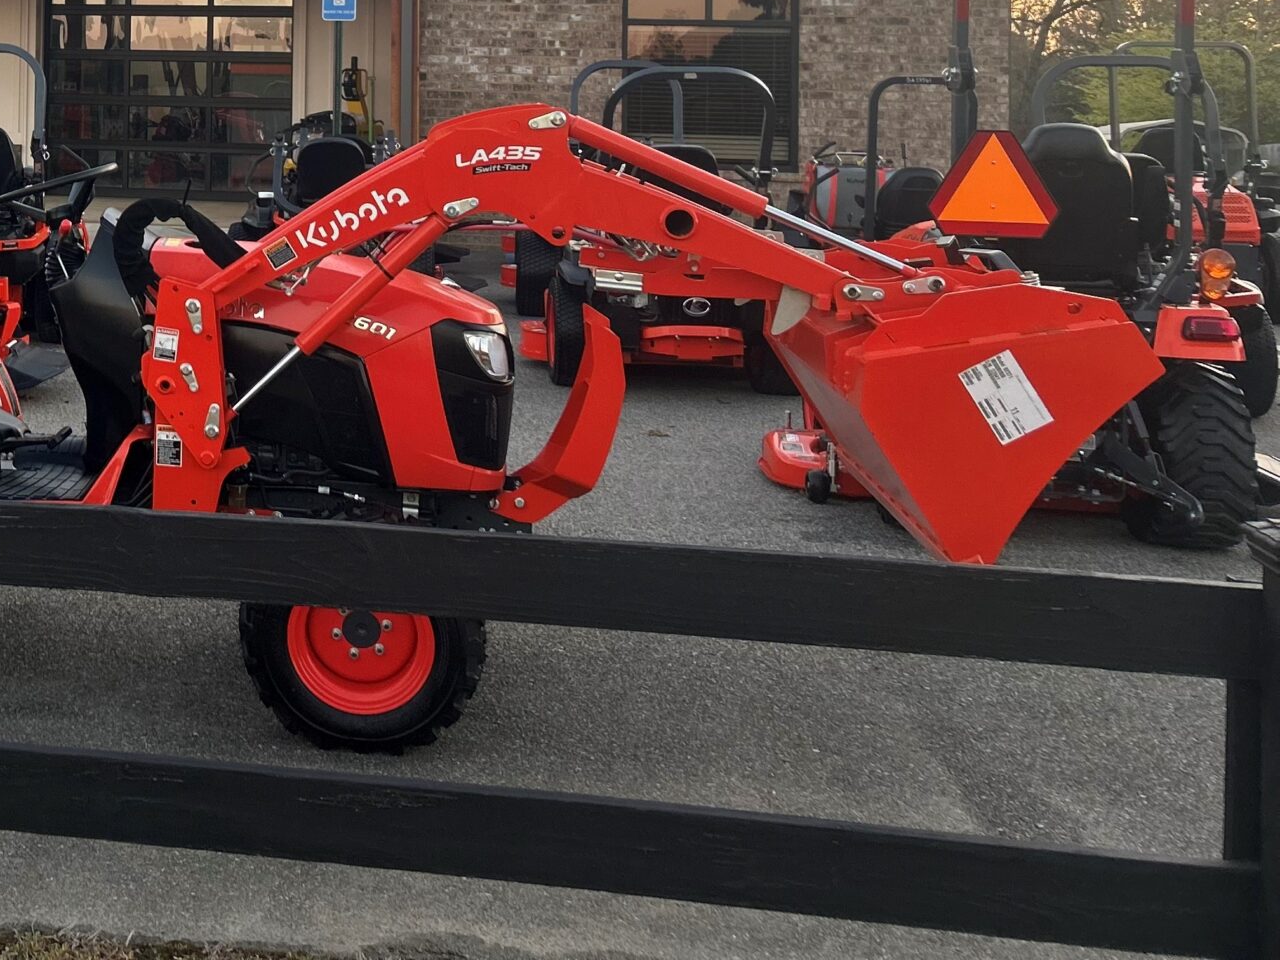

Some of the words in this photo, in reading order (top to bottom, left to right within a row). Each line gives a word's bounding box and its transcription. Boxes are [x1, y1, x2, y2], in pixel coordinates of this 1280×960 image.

[455, 146, 542, 168] LA435
[475, 163, 529, 174] Swift-Tach
[295, 187, 410, 249] Kubota
